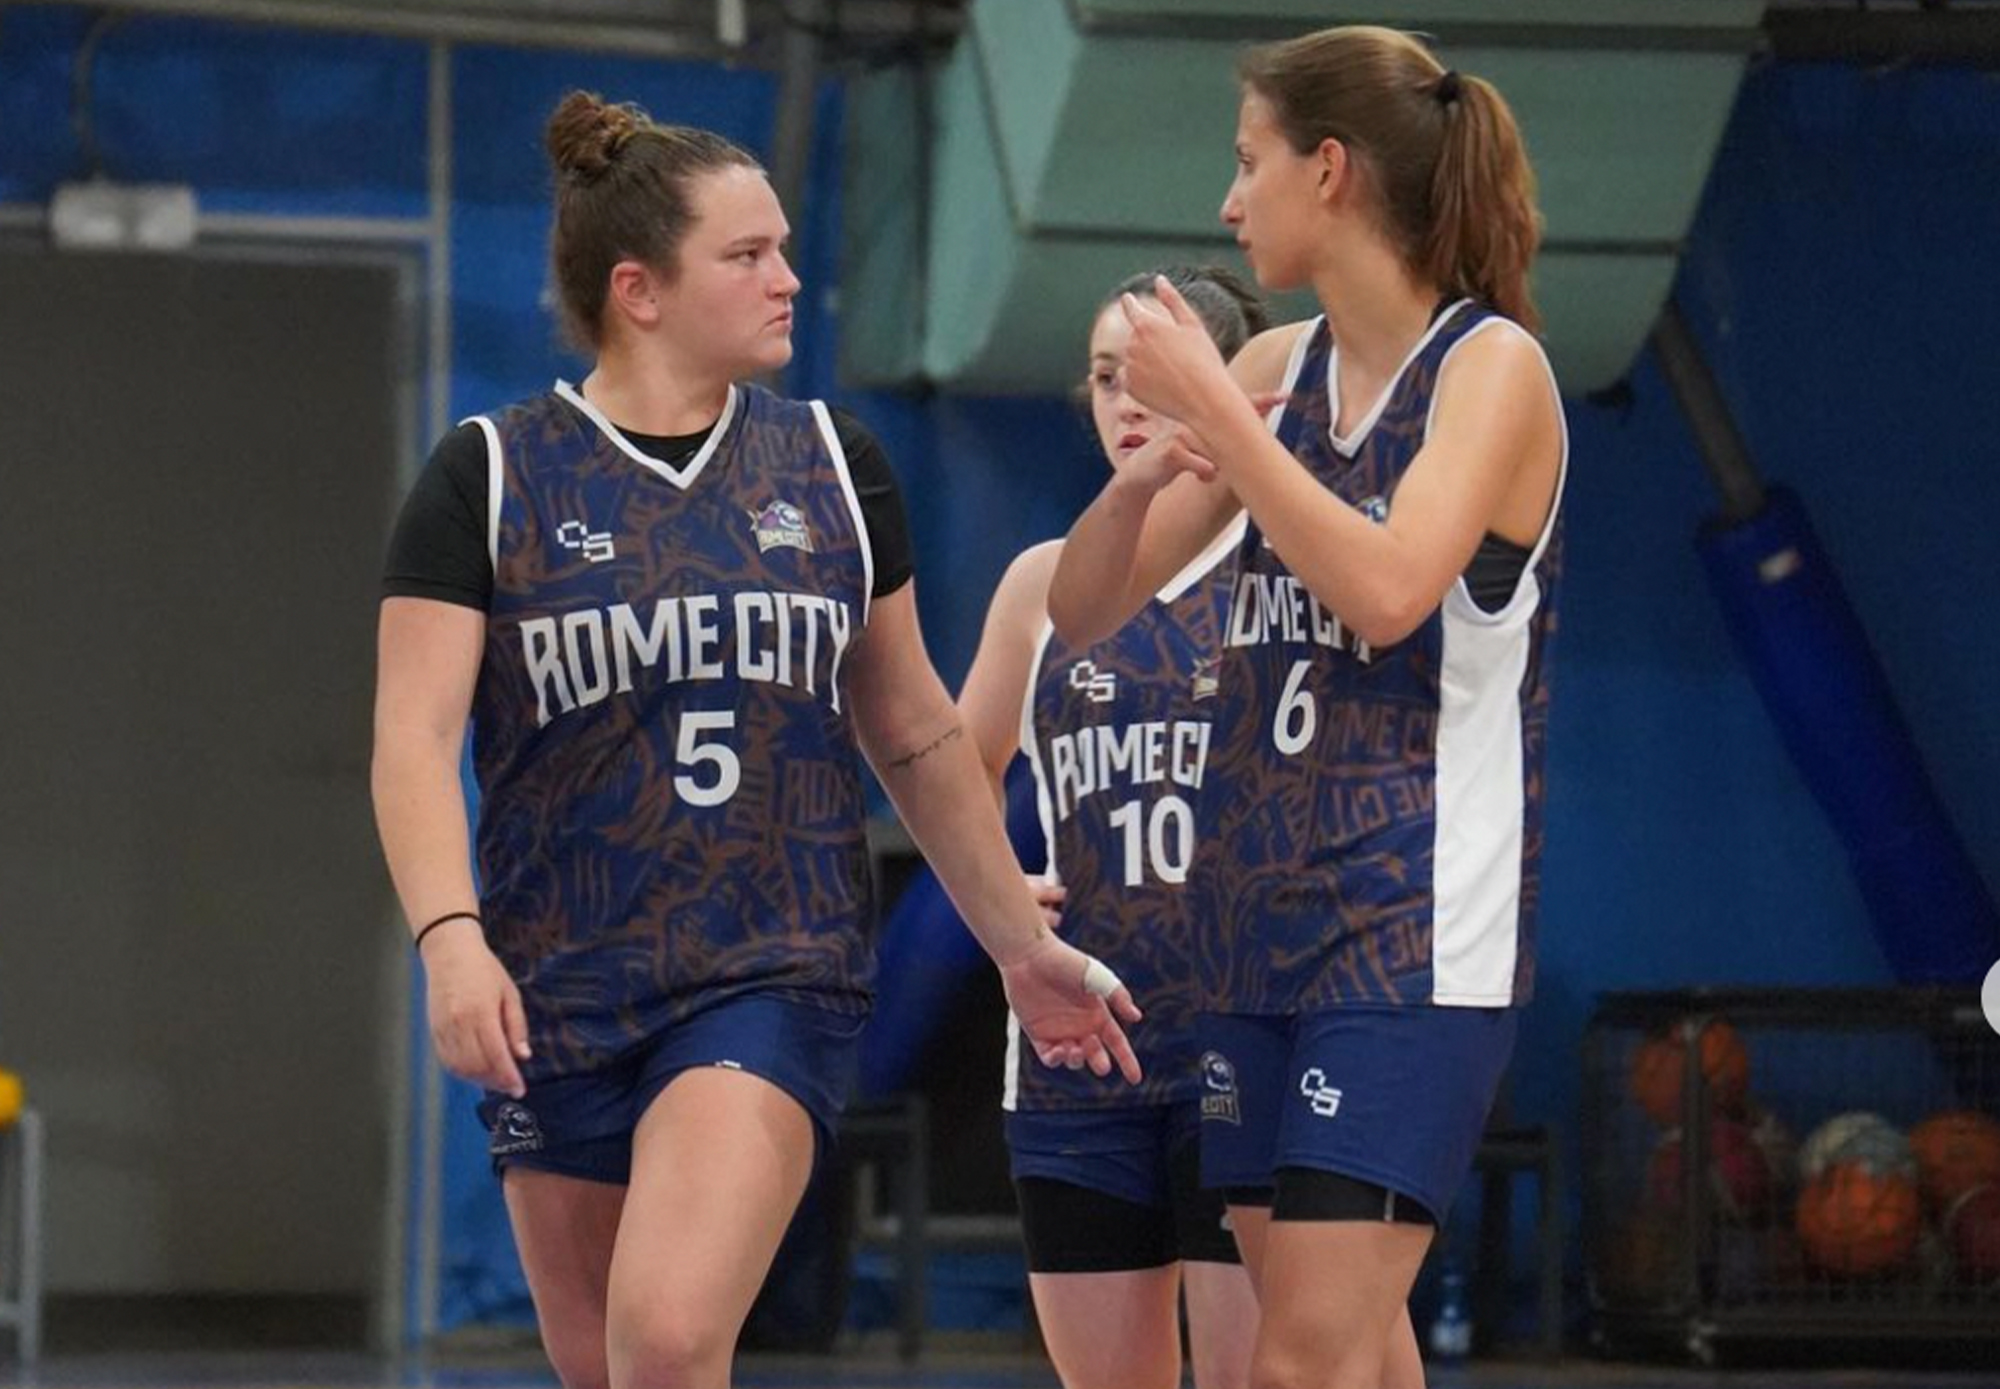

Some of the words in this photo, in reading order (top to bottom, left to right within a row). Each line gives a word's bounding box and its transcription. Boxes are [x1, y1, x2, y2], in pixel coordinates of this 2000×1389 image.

[1222, 572, 1308, 649] OME
[518, 593, 724, 729] ROME
[733, 591, 851, 716] CITY
[1272, 659, 1317, 756] 6
[673, 710, 742, 807] 5
[1171, 720, 1212, 790] CI
[1108, 795, 1195, 887] 10
